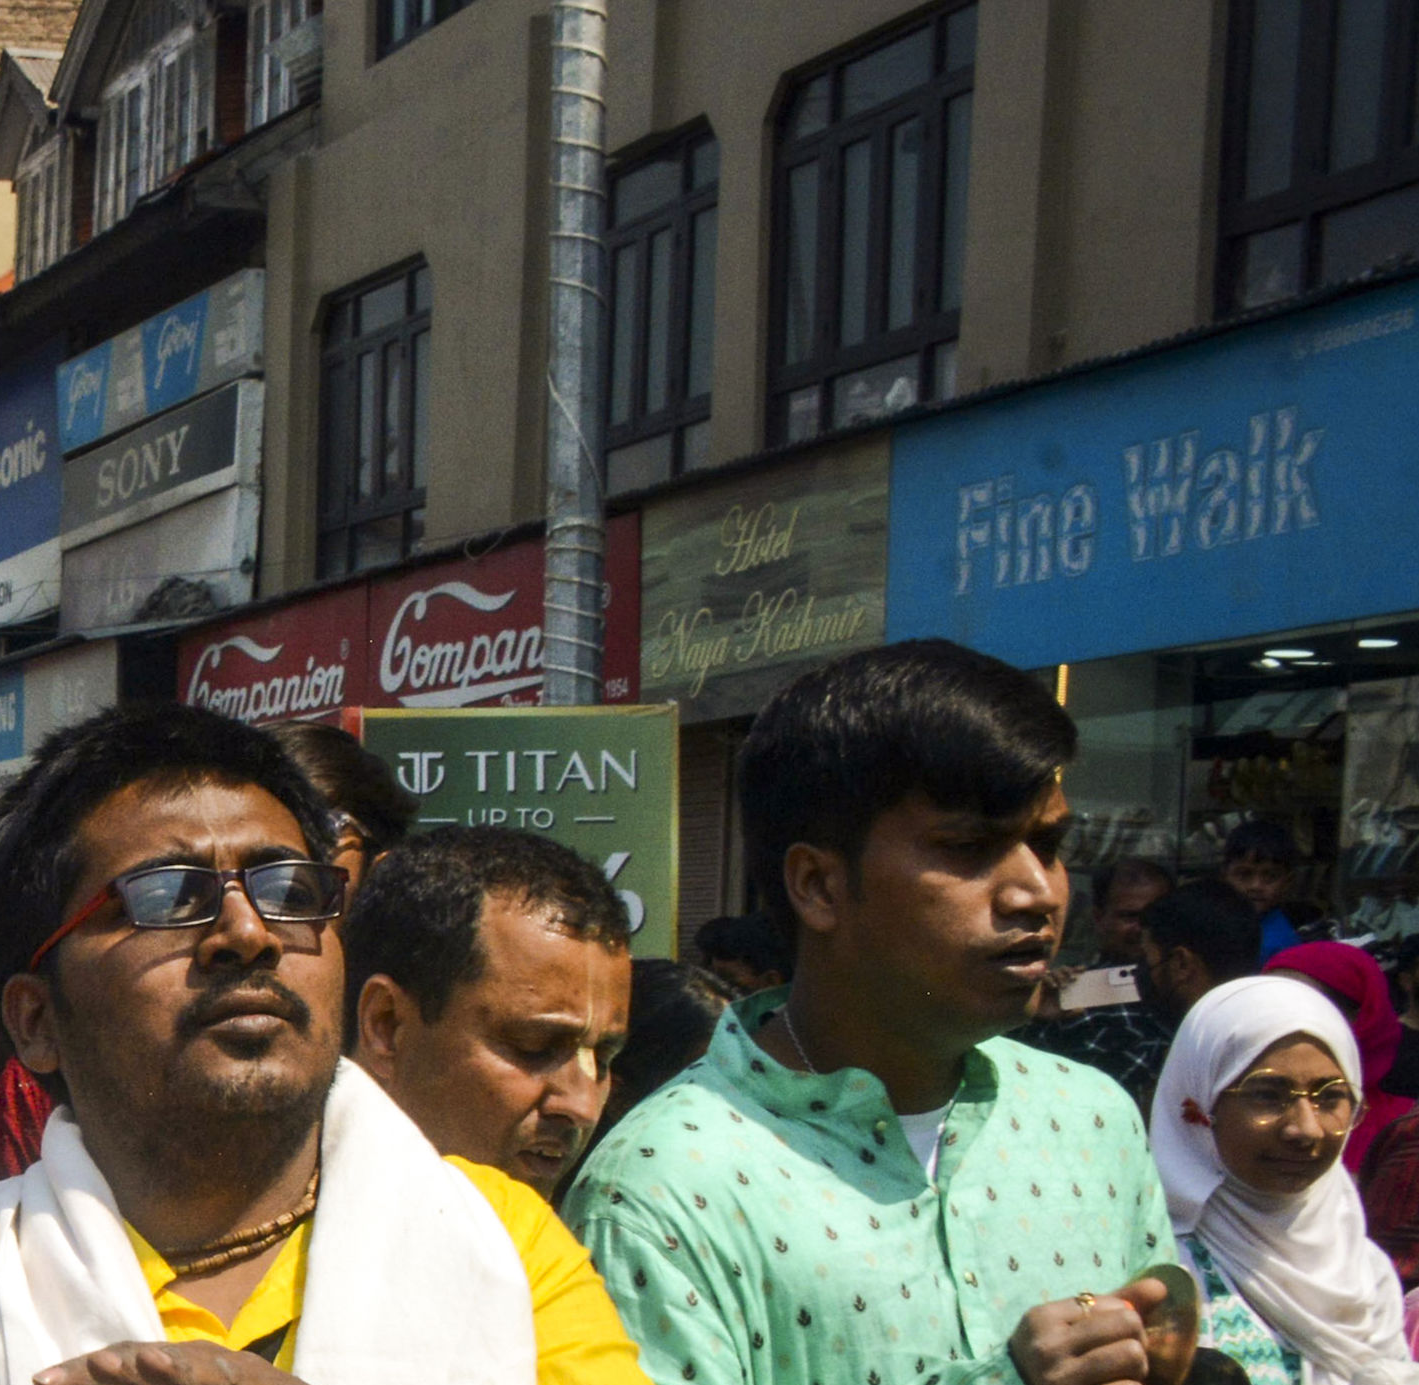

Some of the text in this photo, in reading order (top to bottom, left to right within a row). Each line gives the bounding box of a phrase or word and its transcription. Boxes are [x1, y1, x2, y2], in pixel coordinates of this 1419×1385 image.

[97, 424, 190, 508] SONY
[954, 405, 1326, 597] Fine Walk
[715, 502, 799, 577] Hotel
[379, 580, 547, 693] Compan
[652, 587, 864, 698] Naya Kashmir
[465, 749, 637, 792] TITAN
[468, 807, 554, 829] UP TO
